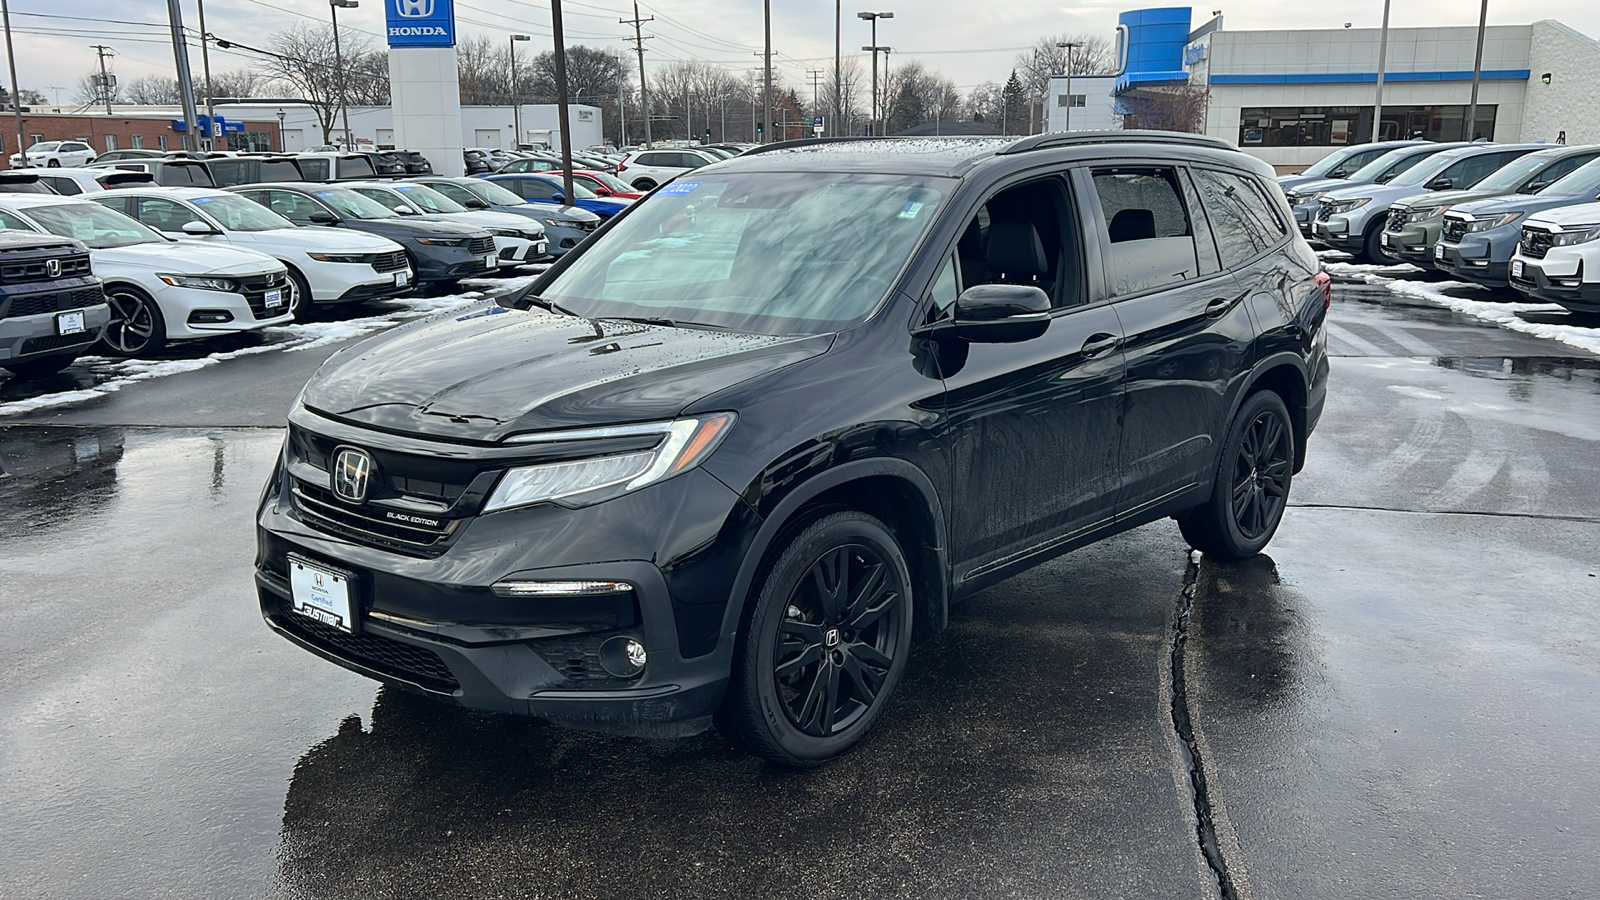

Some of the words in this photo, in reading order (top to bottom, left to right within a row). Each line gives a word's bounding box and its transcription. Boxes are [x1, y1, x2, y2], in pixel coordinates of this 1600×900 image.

[388, 27, 448, 36] HONDA
[386, 511, 410, 521] BLACK
[410, 516, 439, 527] EDITION
[311, 585, 329, 595] HONDA
[311, 593, 333, 607] Certified
